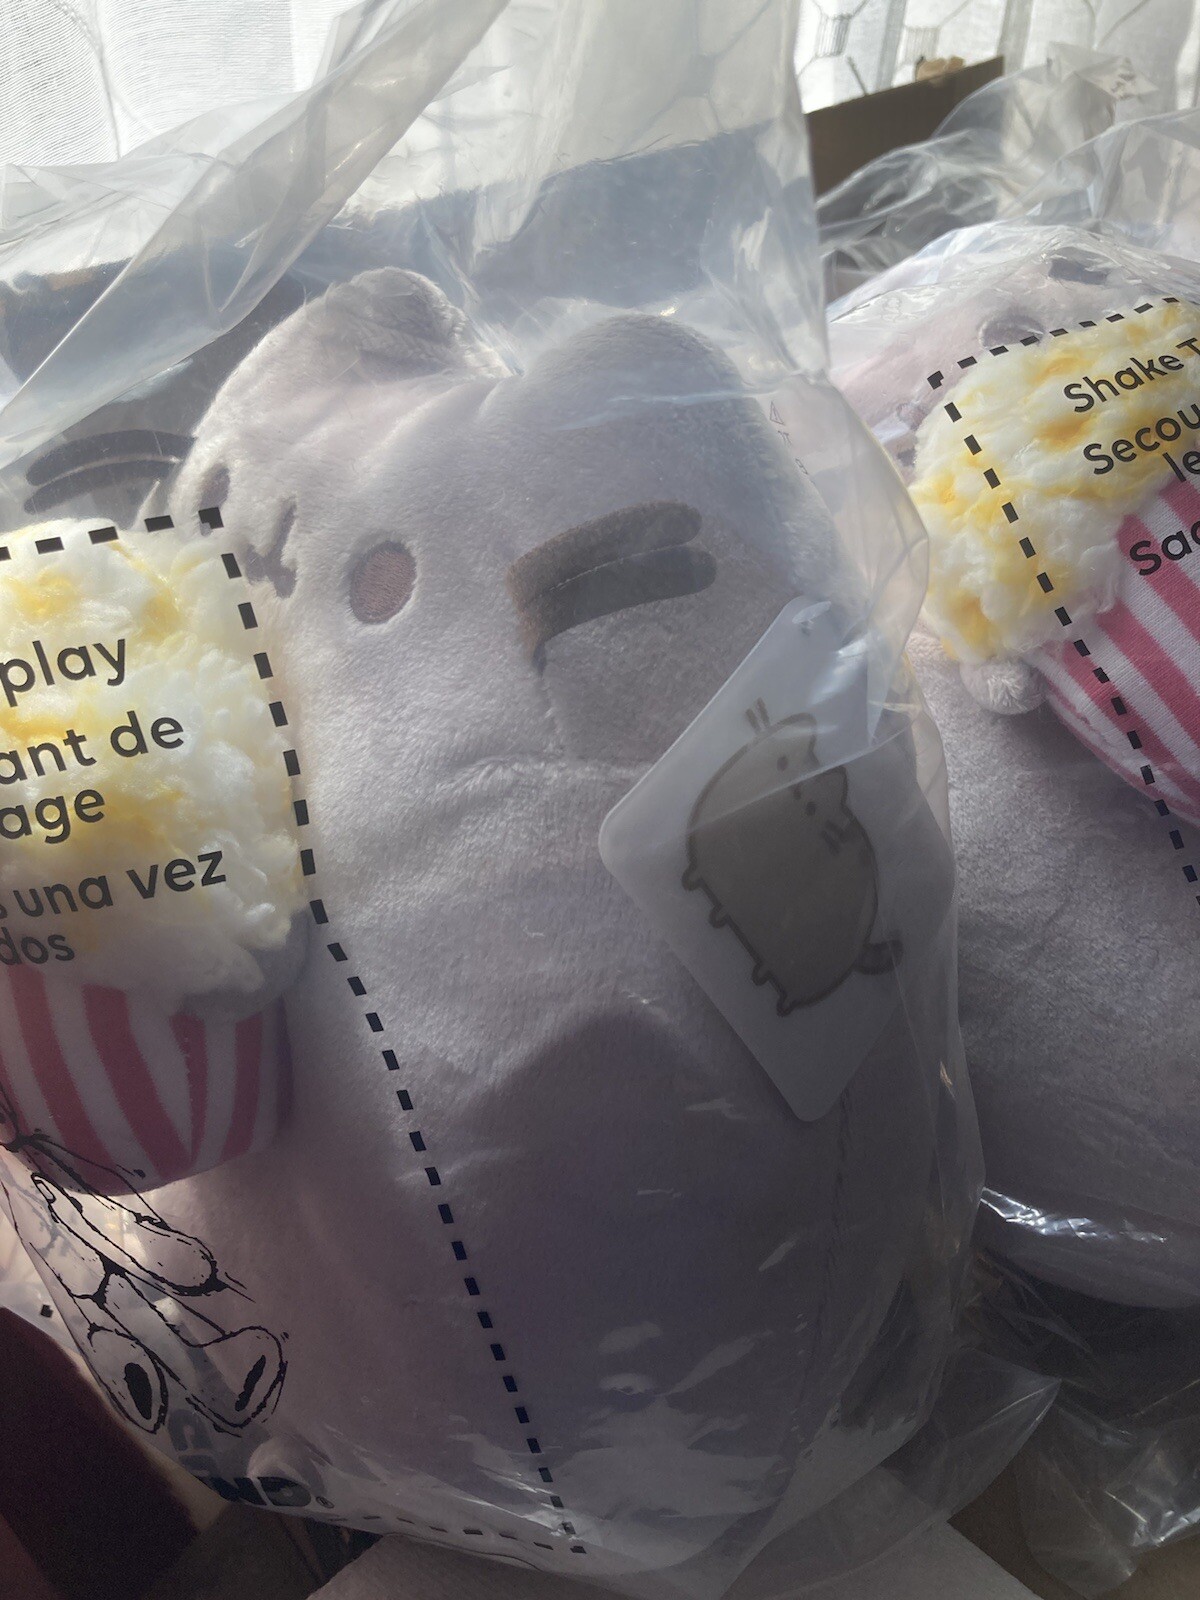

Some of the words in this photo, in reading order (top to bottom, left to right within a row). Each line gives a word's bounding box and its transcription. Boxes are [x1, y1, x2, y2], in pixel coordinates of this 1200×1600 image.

[1064, 355, 1184, 413] Shake
[1083, 403, 1200, 475] Secou
[0, 639, 126, 707] play
[0, 729, 97, 785] ant
[110, 710, 184, 757] de
[0, 789, 105, 844] age
[13, 875, 114, 917] una
[126, 850, 226, 899] vez
